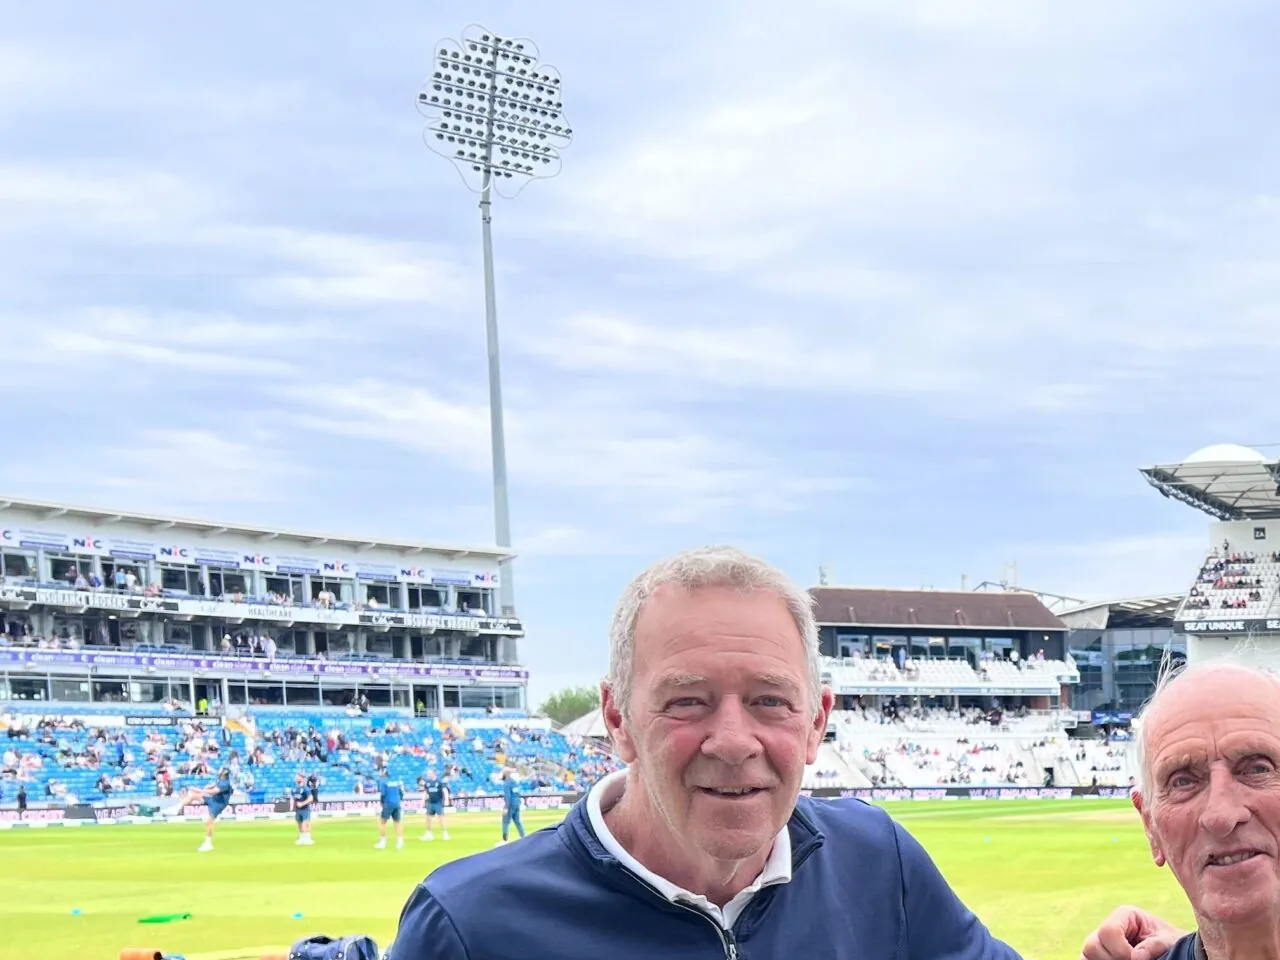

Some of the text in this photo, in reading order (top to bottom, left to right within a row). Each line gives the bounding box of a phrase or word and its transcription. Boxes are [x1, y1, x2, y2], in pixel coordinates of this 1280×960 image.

[1184, 621, 1244, 631] SEAT UNIQUE
[969, 789, 983, 797] WE
[984, 789, 999, 797] ARE
[1099, 788, 1112, 796] WE
[95, 810, 109, 820] WE
